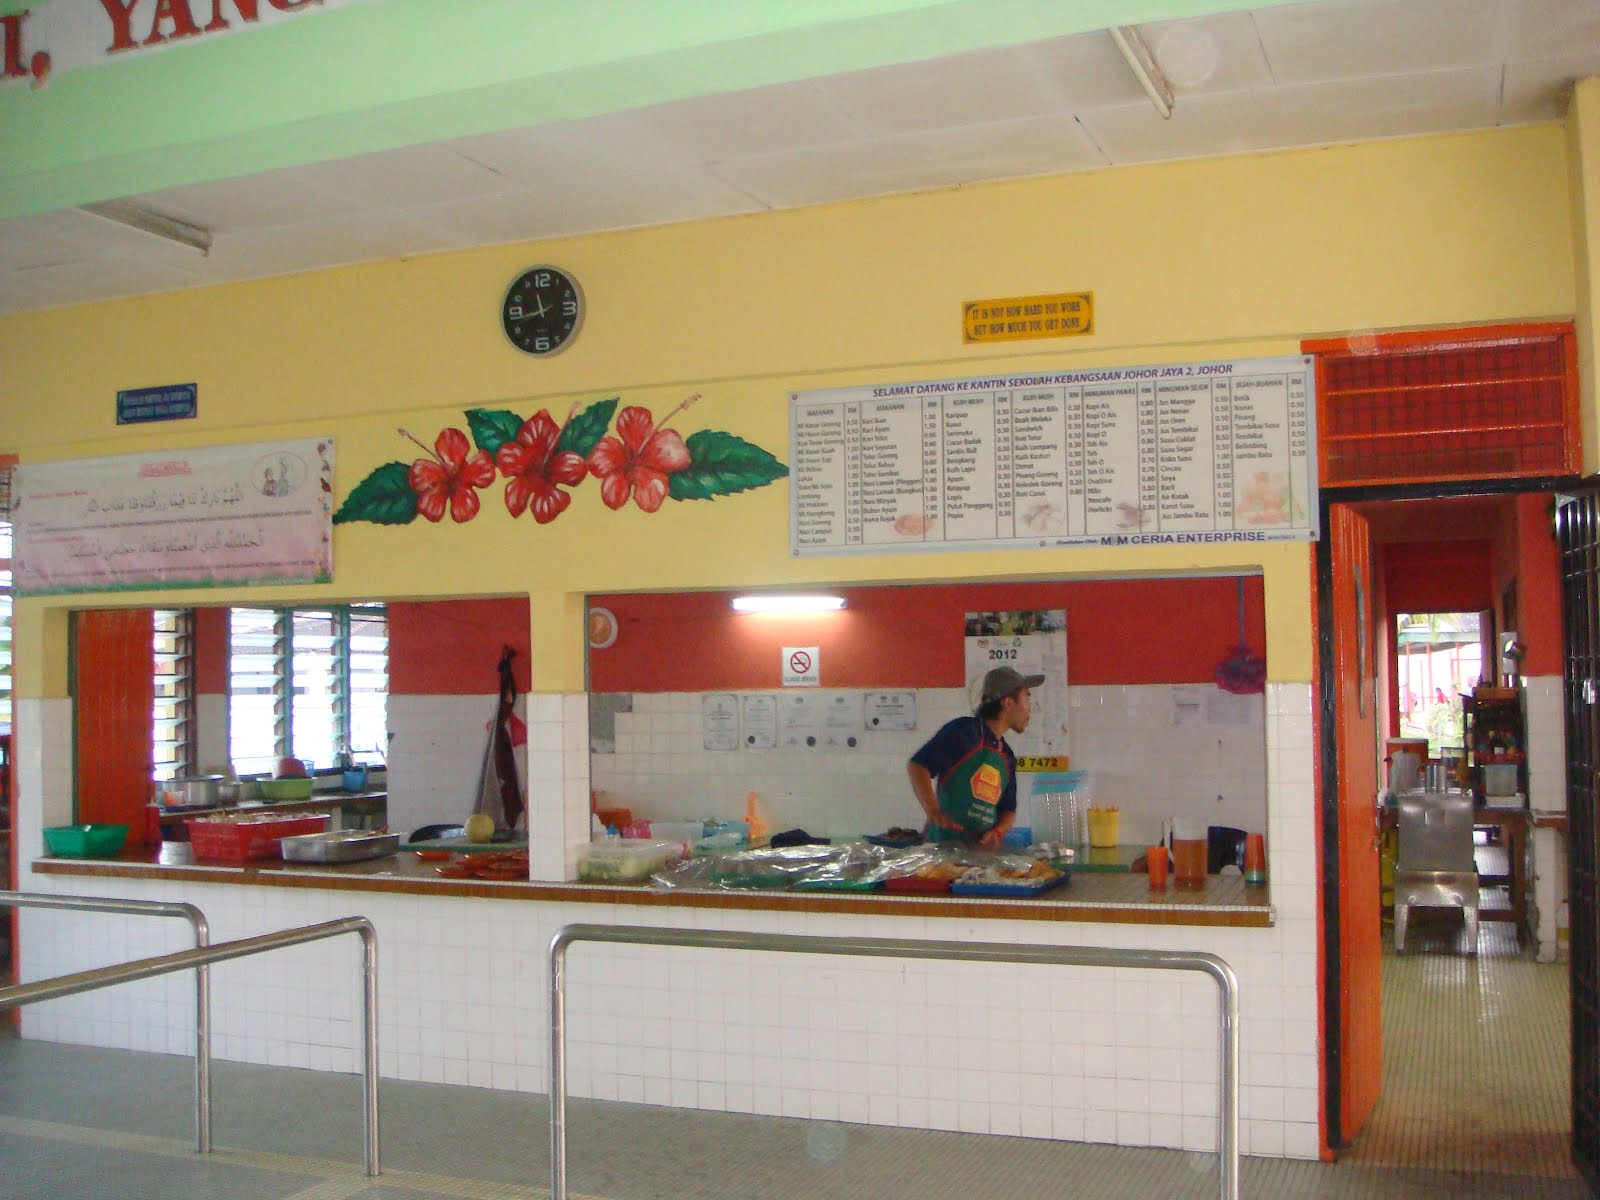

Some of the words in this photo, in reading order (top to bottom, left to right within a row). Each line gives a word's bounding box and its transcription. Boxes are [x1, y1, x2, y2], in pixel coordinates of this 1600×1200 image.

[535, 273, 550, 288] 12
[509, 306, 523, 320] 9
[562, 301, 576, 316] 3
[972, 309, 979, 320] IT
[982, 308, 988, 319] IS
[991, 307, 1003, 318] NOT
[1006, 306, 1022, 317] HOW
[1024, 304, 1043, 316] HARD
[1045, 303, 1058, 314] YOU
[1061, 301, 1080, 313] WORK
[974, 325, 987, 336] BUT
[990, 323, 1005, 334] HOW
[1007, 321, 1027, 333] MUCH
[1029, 320, 1043, 332] YOU
[1045, 319, 1058, 330] GET
[1061, 317, 1080, 329] DONE
[535, 336, 550, 351] 6
[873, 385, 915, 398] SELAMAT
[916, 382, 955, 394] DATANG
[957, 382, 969, 391] KE
[970, 379, 1007, 390] KANTIN
[1008, 376, 1053, 388] SEKOLAH
[1054, 371, 1121, 384] KEBANGSAAN
[1123, 368, 1158, 380] JOHOR
[1159, 367, 1184, 377] JAYA
[1185, 367, 1194, 377] 2,
[1197, 364, 1233, 375] JOHOR
[1100, 536, 1112, 546] M
[1131, 534, 1174, 545] CERIA
[1176, 531, 1265, 543] ENTERPRISE
[989, 649, 1017, 660] 2012
[1029, 757, 1058, 768] 7472
